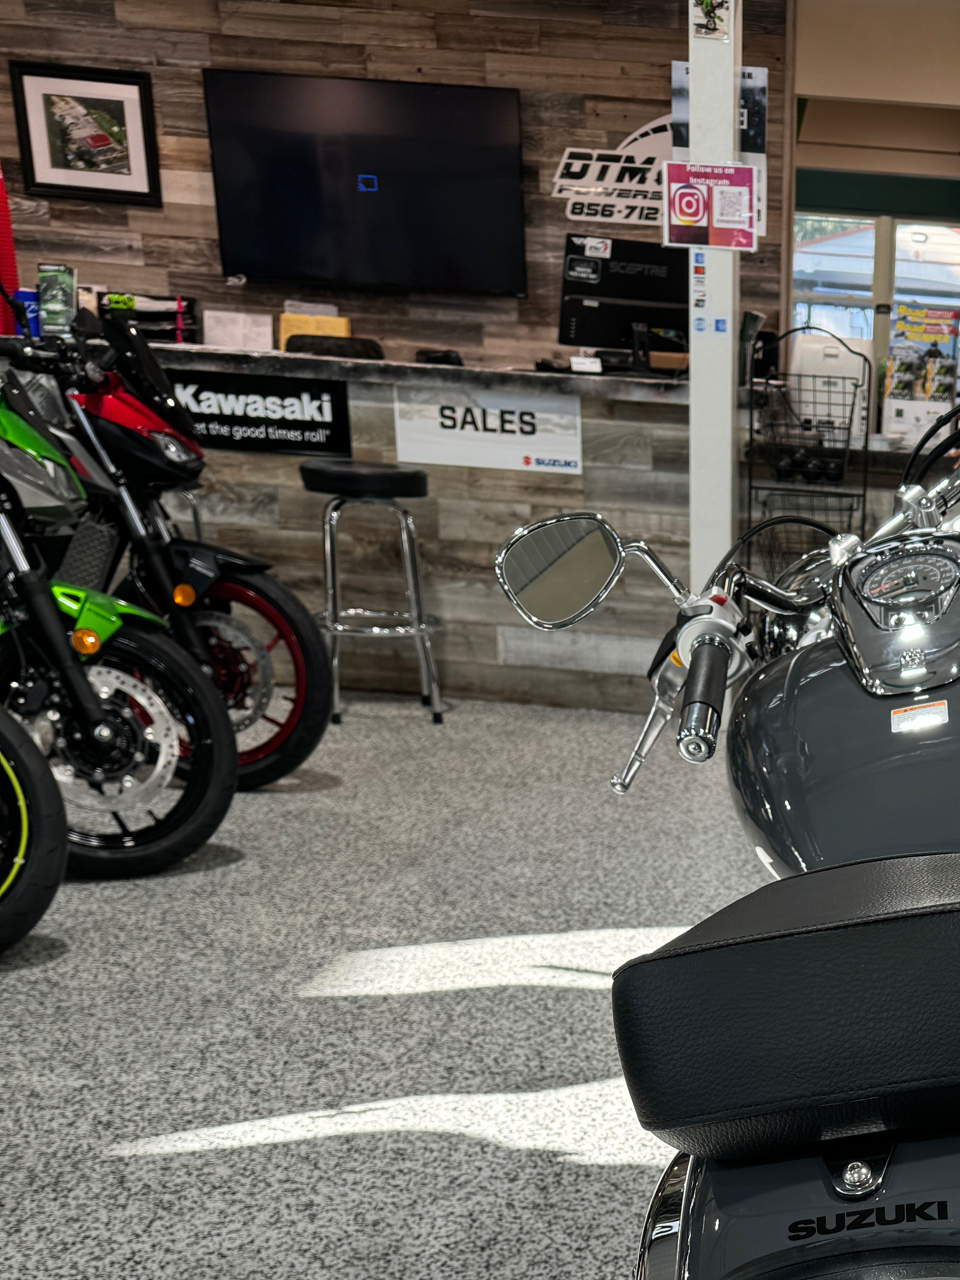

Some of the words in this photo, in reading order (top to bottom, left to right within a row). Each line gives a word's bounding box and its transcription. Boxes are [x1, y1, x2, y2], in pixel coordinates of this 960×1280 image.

[560, 151, 656, 185] DTM
[687, 164, 712, 173] Follow
[608, 261, 668, 277] SCEPTRE
[174, 383, 333, 423] Kawasaki
[208, 421, 231, 436] the
[231, 424, 266, 440] good
[267, 425, 302, 442] times
[439, 405, 537, 435] SALES
[534, 458, 578, 468] SUZUKI
[788, 1200, 948, 1241] SUZUKI
